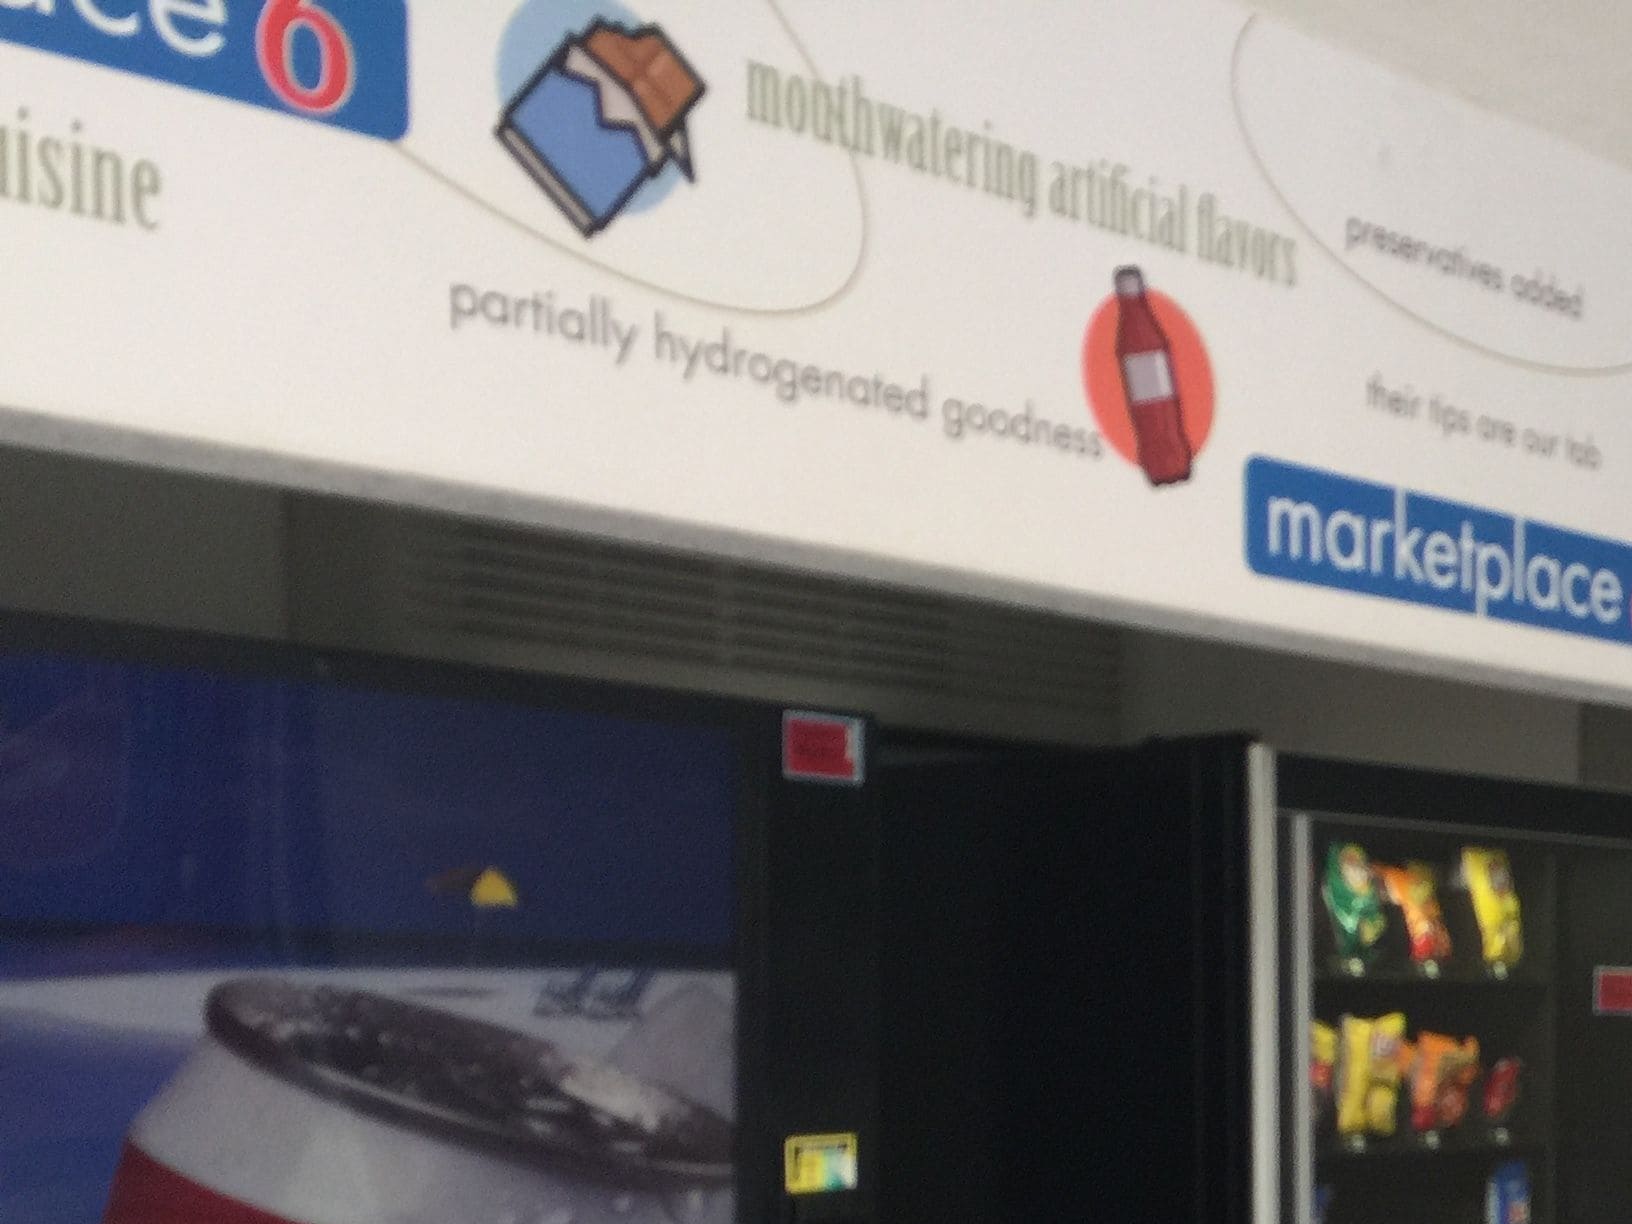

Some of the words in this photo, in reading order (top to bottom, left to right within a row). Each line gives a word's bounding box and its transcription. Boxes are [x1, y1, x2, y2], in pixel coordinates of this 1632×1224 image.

[746, 58, 1037, 218] mouthwatering
[1048, 158, 1188, 254] artificial
[1197, 192, 1297, 288] flavors
[449, 282, 639, 366] partially
[652, 310, 930, 421] hydrogenated
[941, 390, 1103, 462] goodness
[1267, 484, 1624, 625] marketplace
